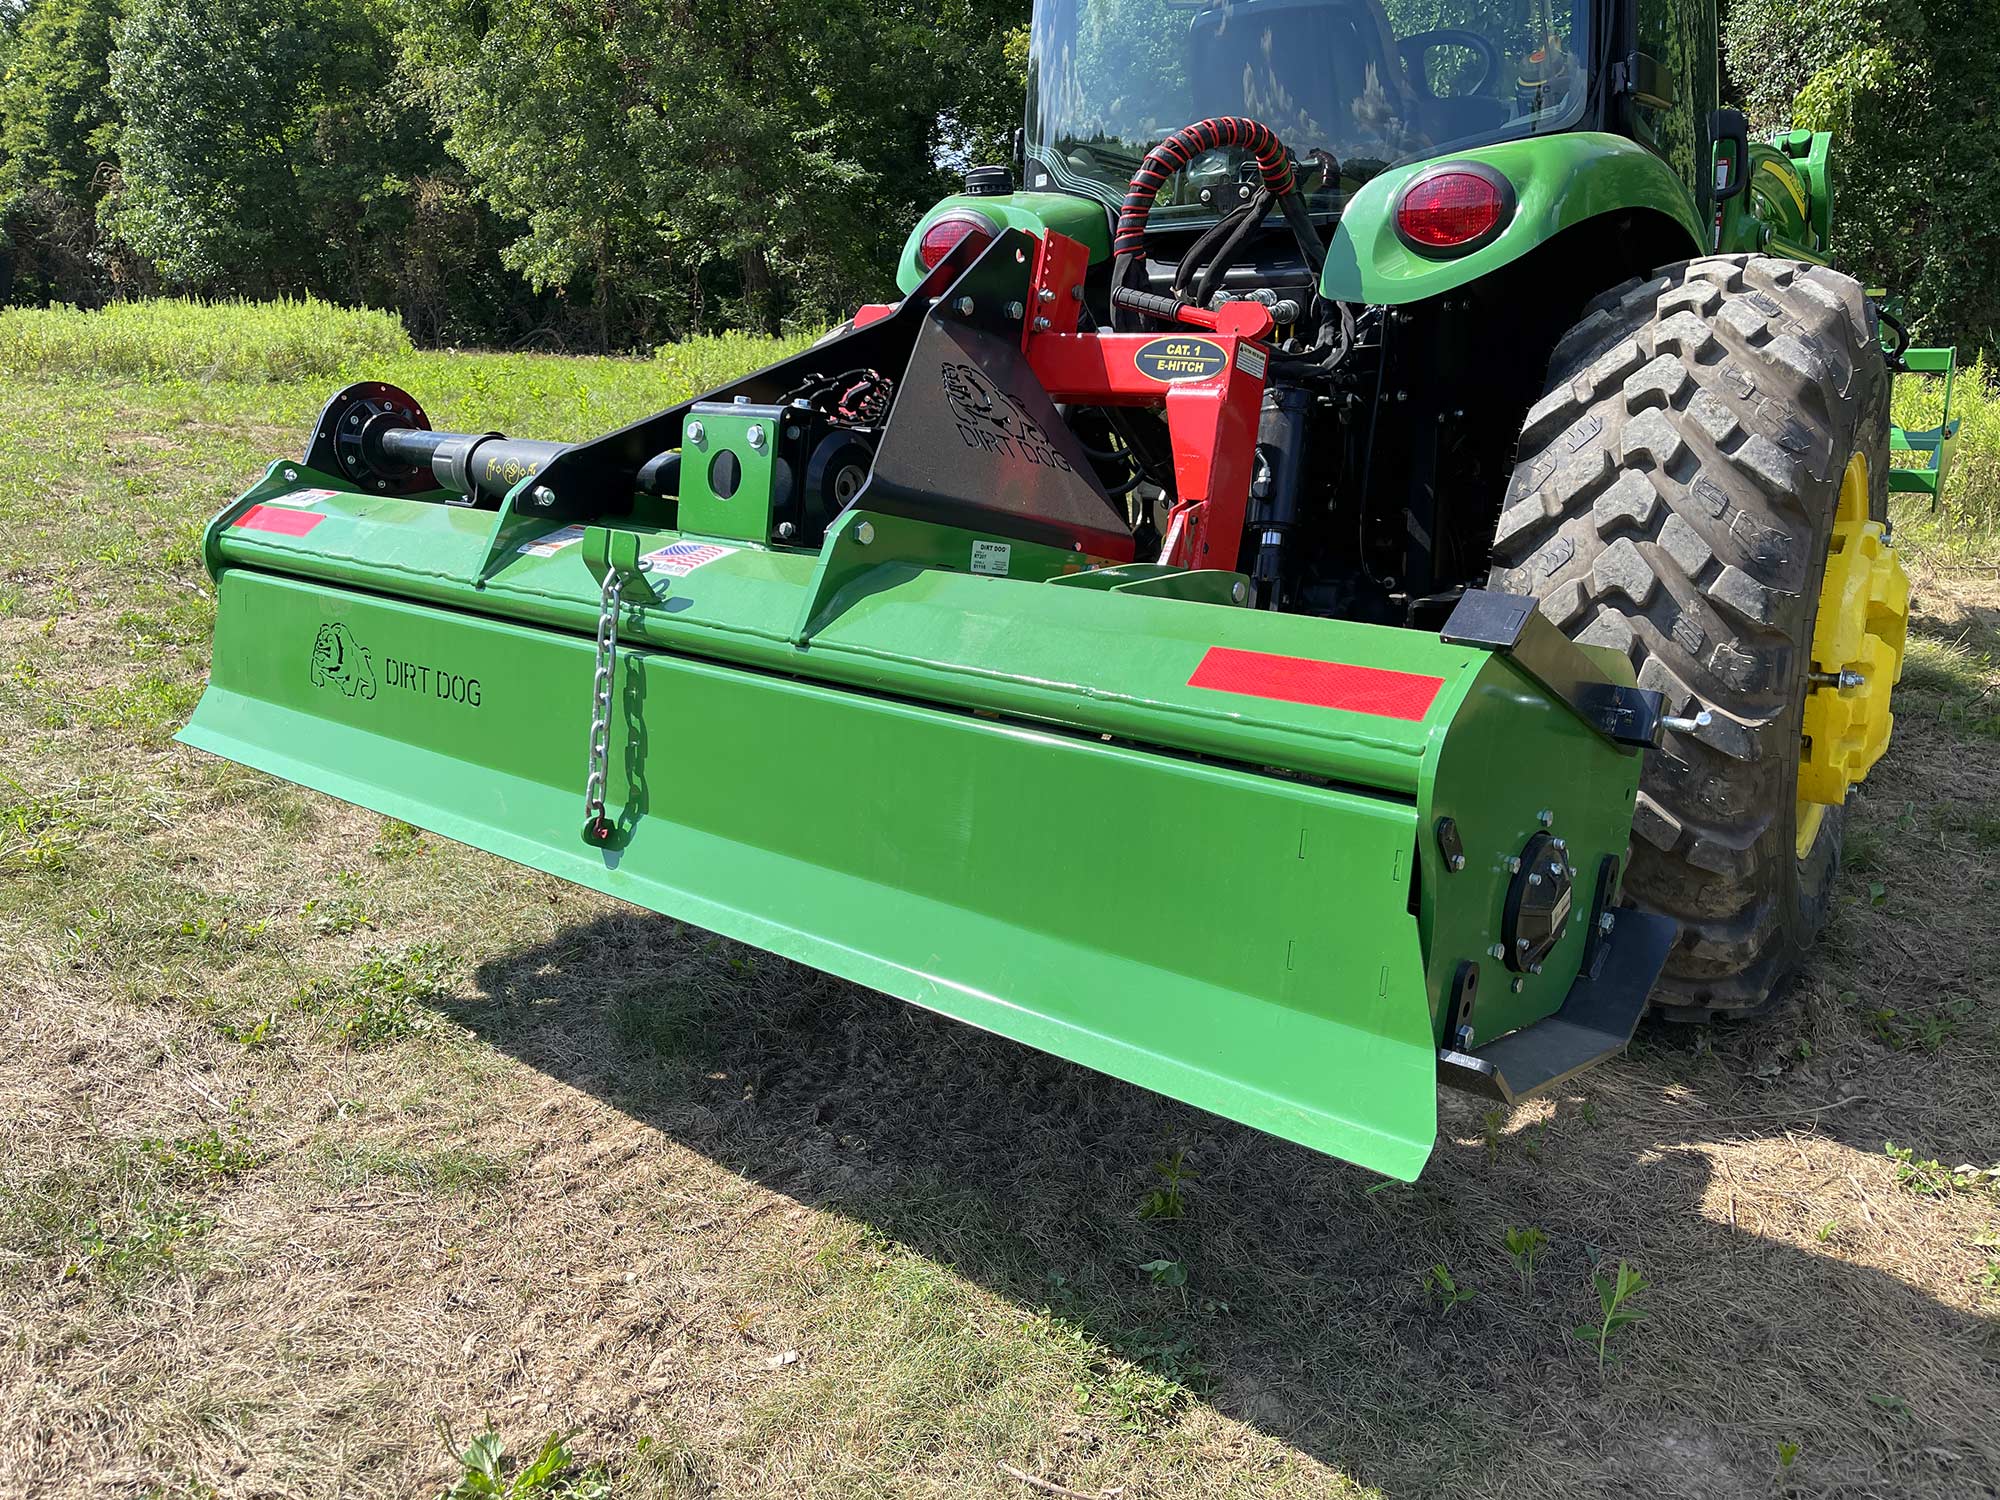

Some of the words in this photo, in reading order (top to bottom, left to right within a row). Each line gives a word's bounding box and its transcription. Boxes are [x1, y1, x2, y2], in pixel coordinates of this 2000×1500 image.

[1166, 343, 1191, 356] CAT.
[1194, 345, 1201, 356] 1
[1156, 360, 1205, 373] E-HITCH
[955, 423, 1015, 458] DIRT
[1017, 440, 1072, 472] DOG
[386, 658, 430, 693] DIRT
[436, 671, 481, 707] DOG
